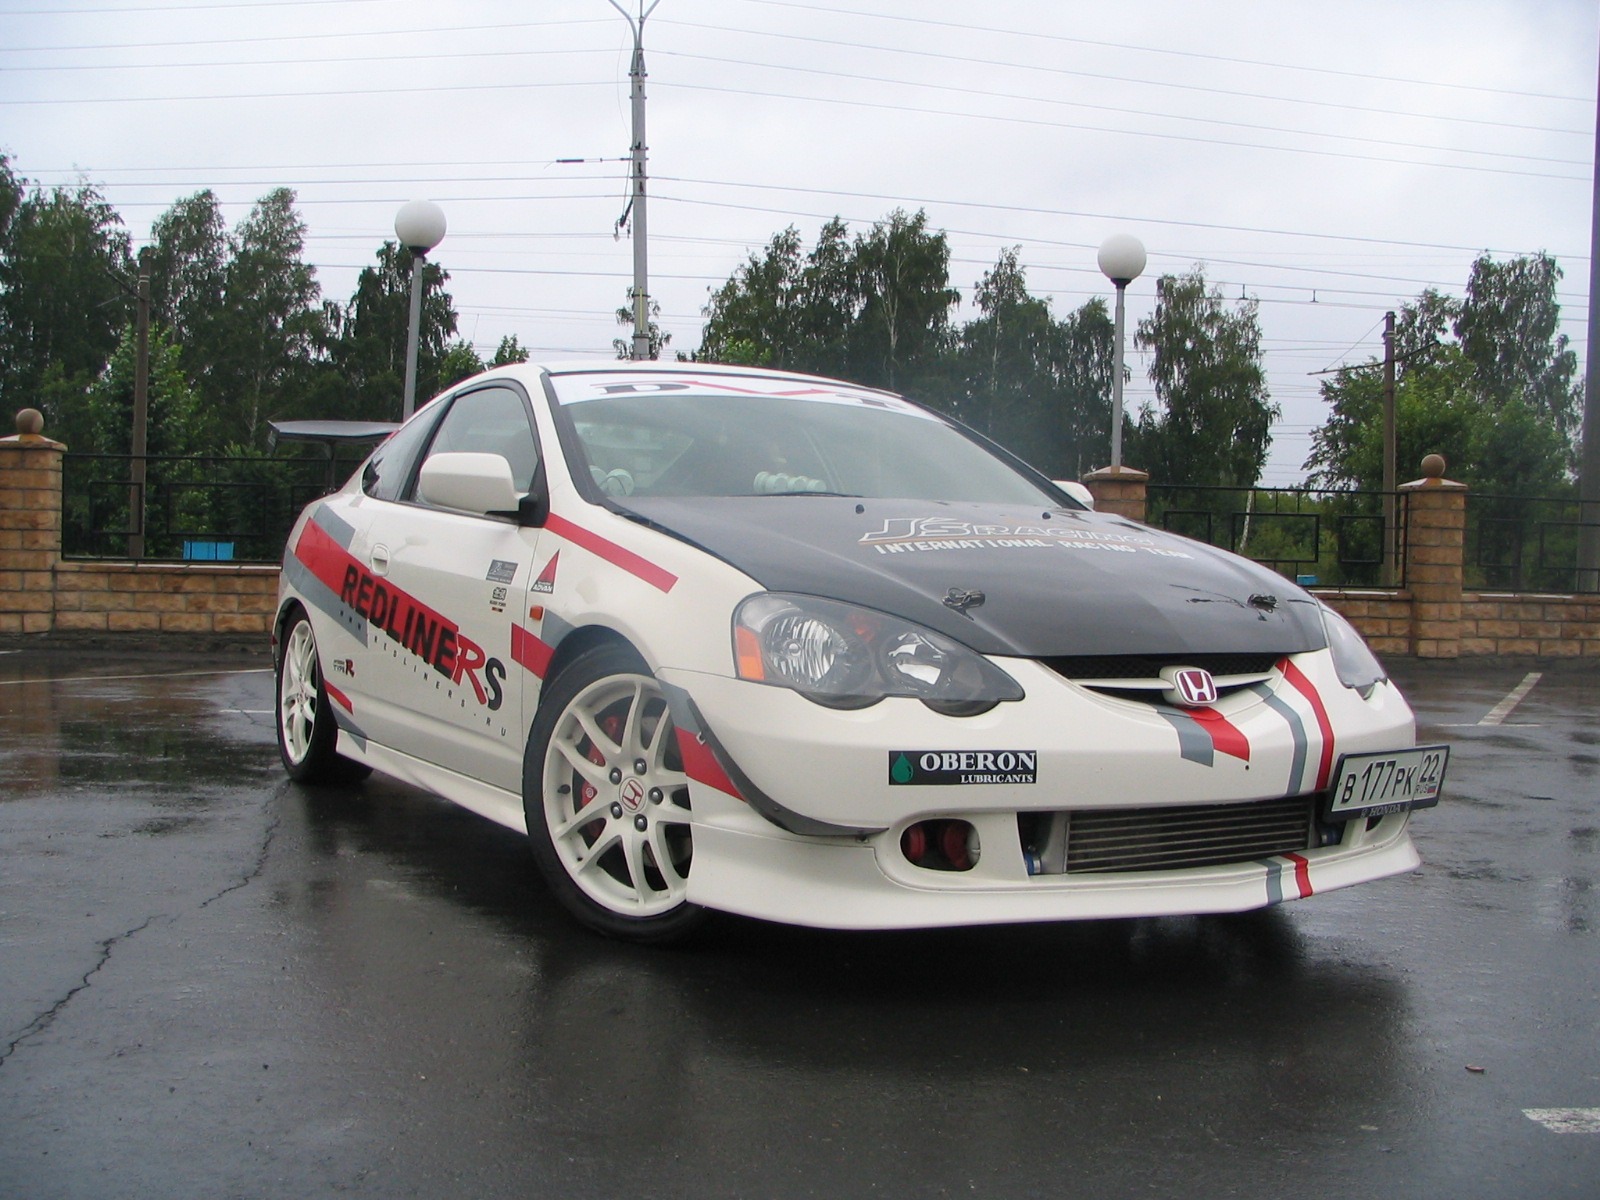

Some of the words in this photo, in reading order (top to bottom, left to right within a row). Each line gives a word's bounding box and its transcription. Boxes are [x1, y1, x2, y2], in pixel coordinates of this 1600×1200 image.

[874, 539, 1053, 555] INTERNATIONAL
[1056, 539, 1136, 553] RACING
[532, 583, 553, 592] ADVAN
[340, 562, 507, 711] REDLINERS
[919, 752, 1036, 772] OBERON
[1420, 753, 1440, 783] 22
[960, 774, 1034, 784] LUBRICANTS
[1369, 803, 1402, 816] HONDA
